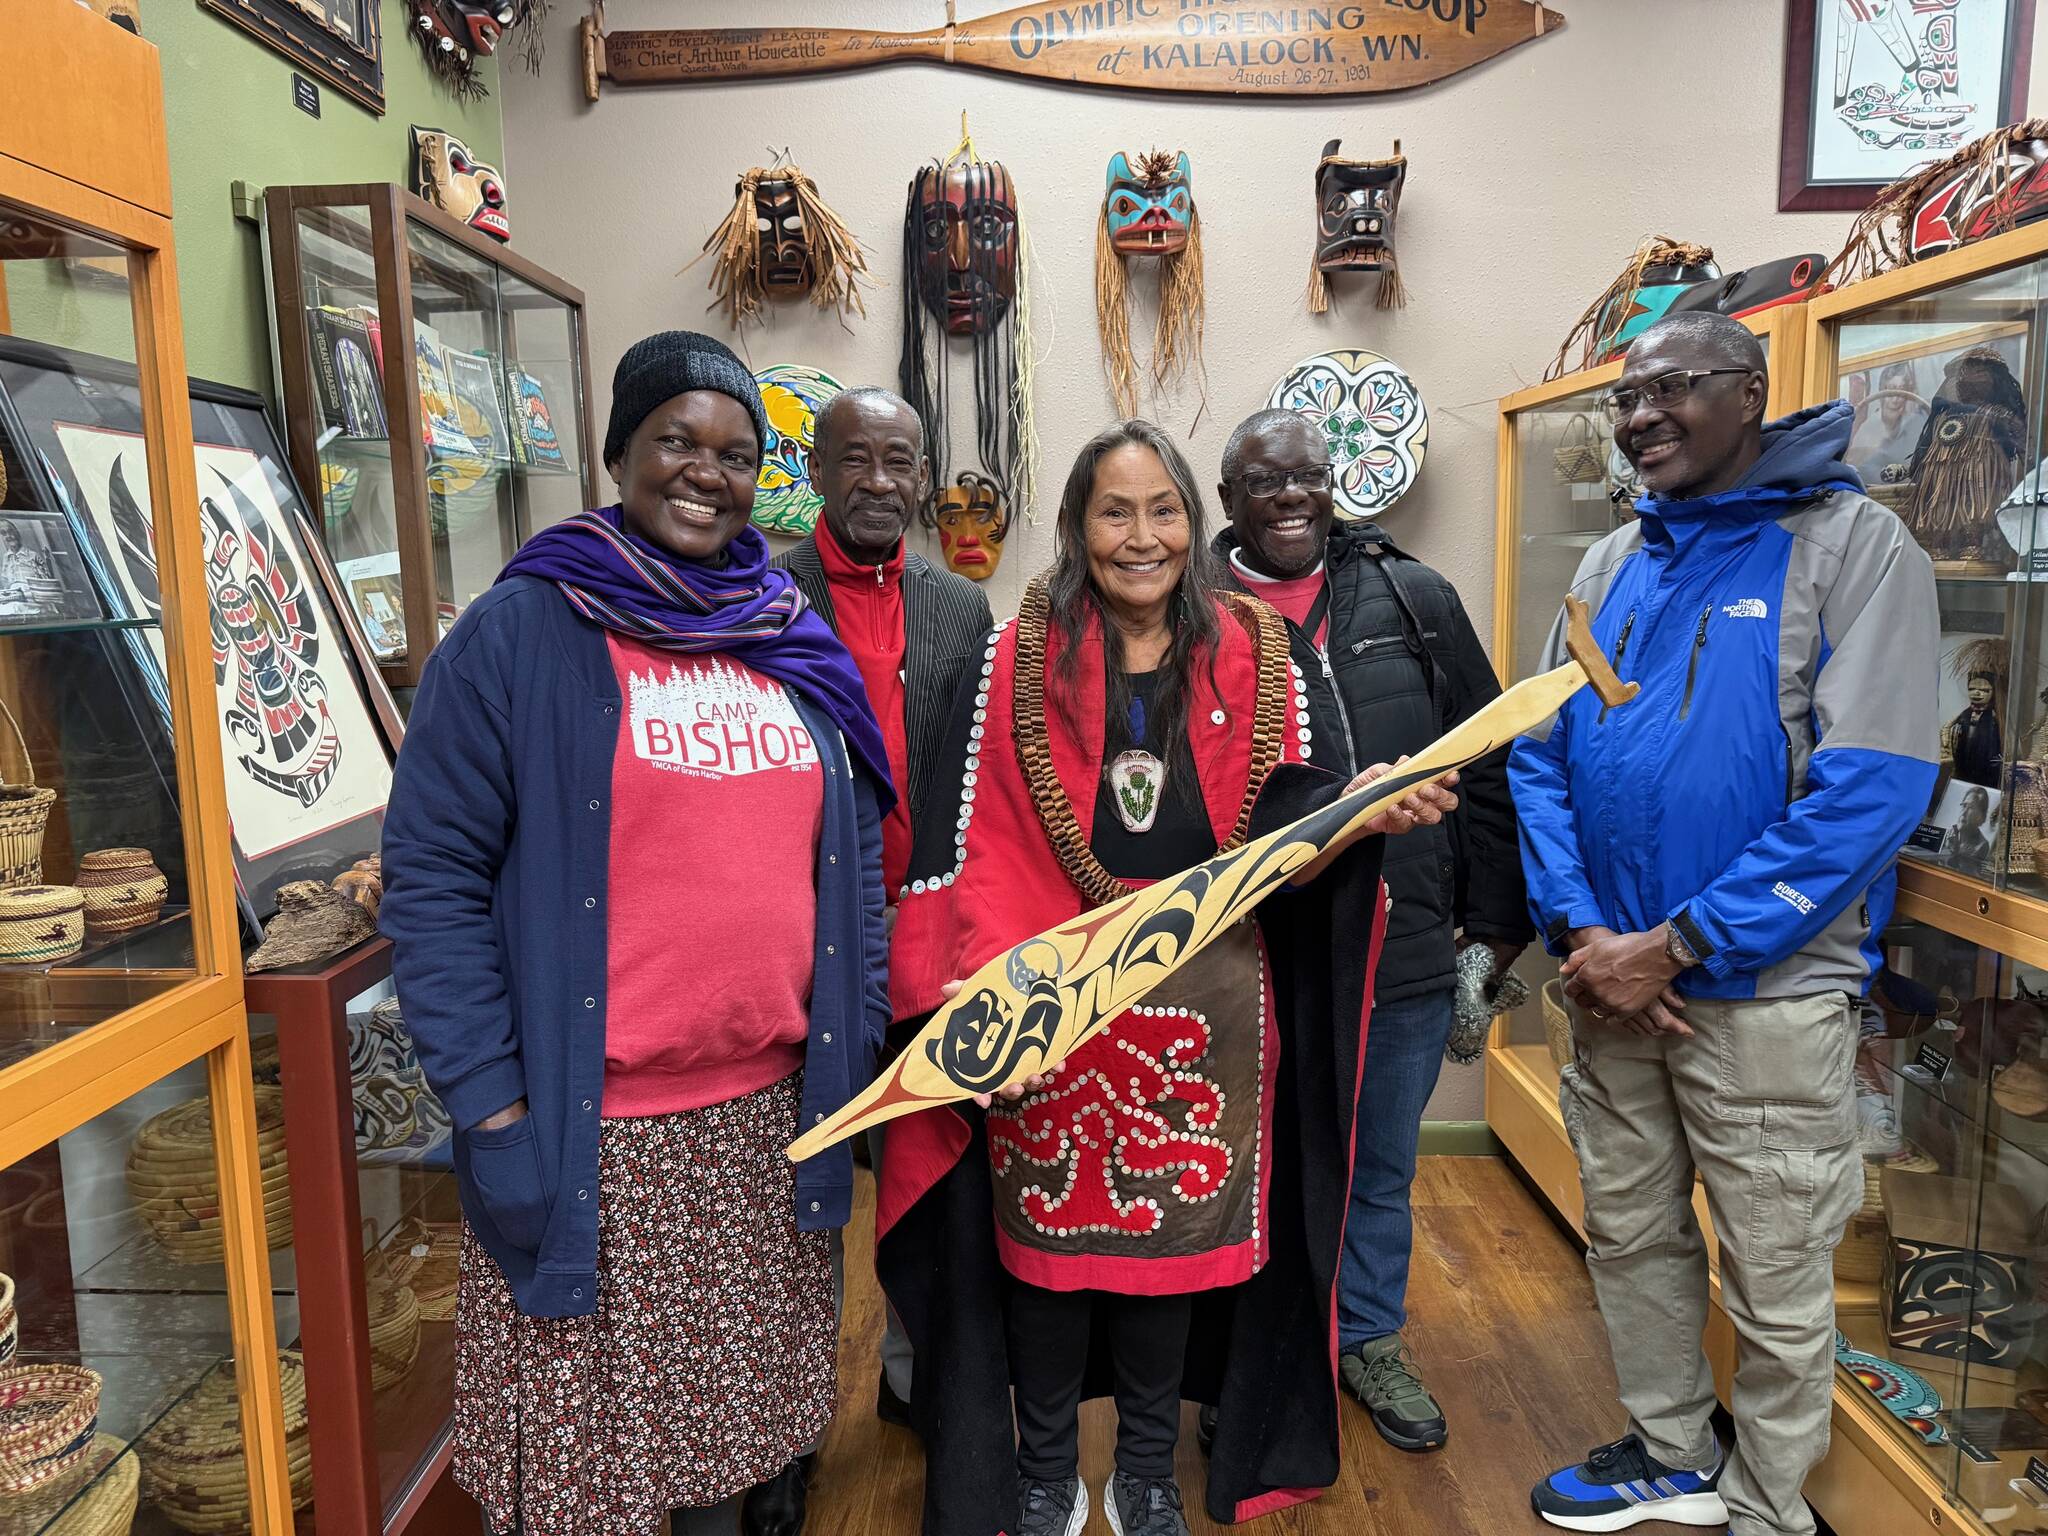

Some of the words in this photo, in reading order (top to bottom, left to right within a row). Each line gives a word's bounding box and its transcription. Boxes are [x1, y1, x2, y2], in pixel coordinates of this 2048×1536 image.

[1010, 0, 1159, 59] OLYMPIC
[1178, 6, 1365, 37] OPENING
[669, 33, 762, 48] DEVELOPMENT
[772, 31, 830, 41] LEAGUE
[842, 36, 861, 50] In
[868, 35, 913, 49] honor
[953, 31, 976, 46] the
[637, 50, 683, 67] Chief
[687, 47, 741, 64] Arthur
[748, 42, 826, 61] Howeattle
[1096, 46, 1131, 75] at
[1362, 34, 1431, 61] WN.
[1228, 69, 1287, 87] August
[1345, 66, 1371, 81] 1931
[1722, 604, 1754, 613] NORTH
[1729, 610, 1752, 618] FACE
[696, 702, 758, 721] CAMP
[645, 718, 812, 771] BISHOP
[651, 760, 672, 772] YMCA
[673, 763, 681, 772] of
[681, 765, 700, 778] Grays
[701, 769, 723, 781] Harbor
[801, 764, 812, 772] 1954
